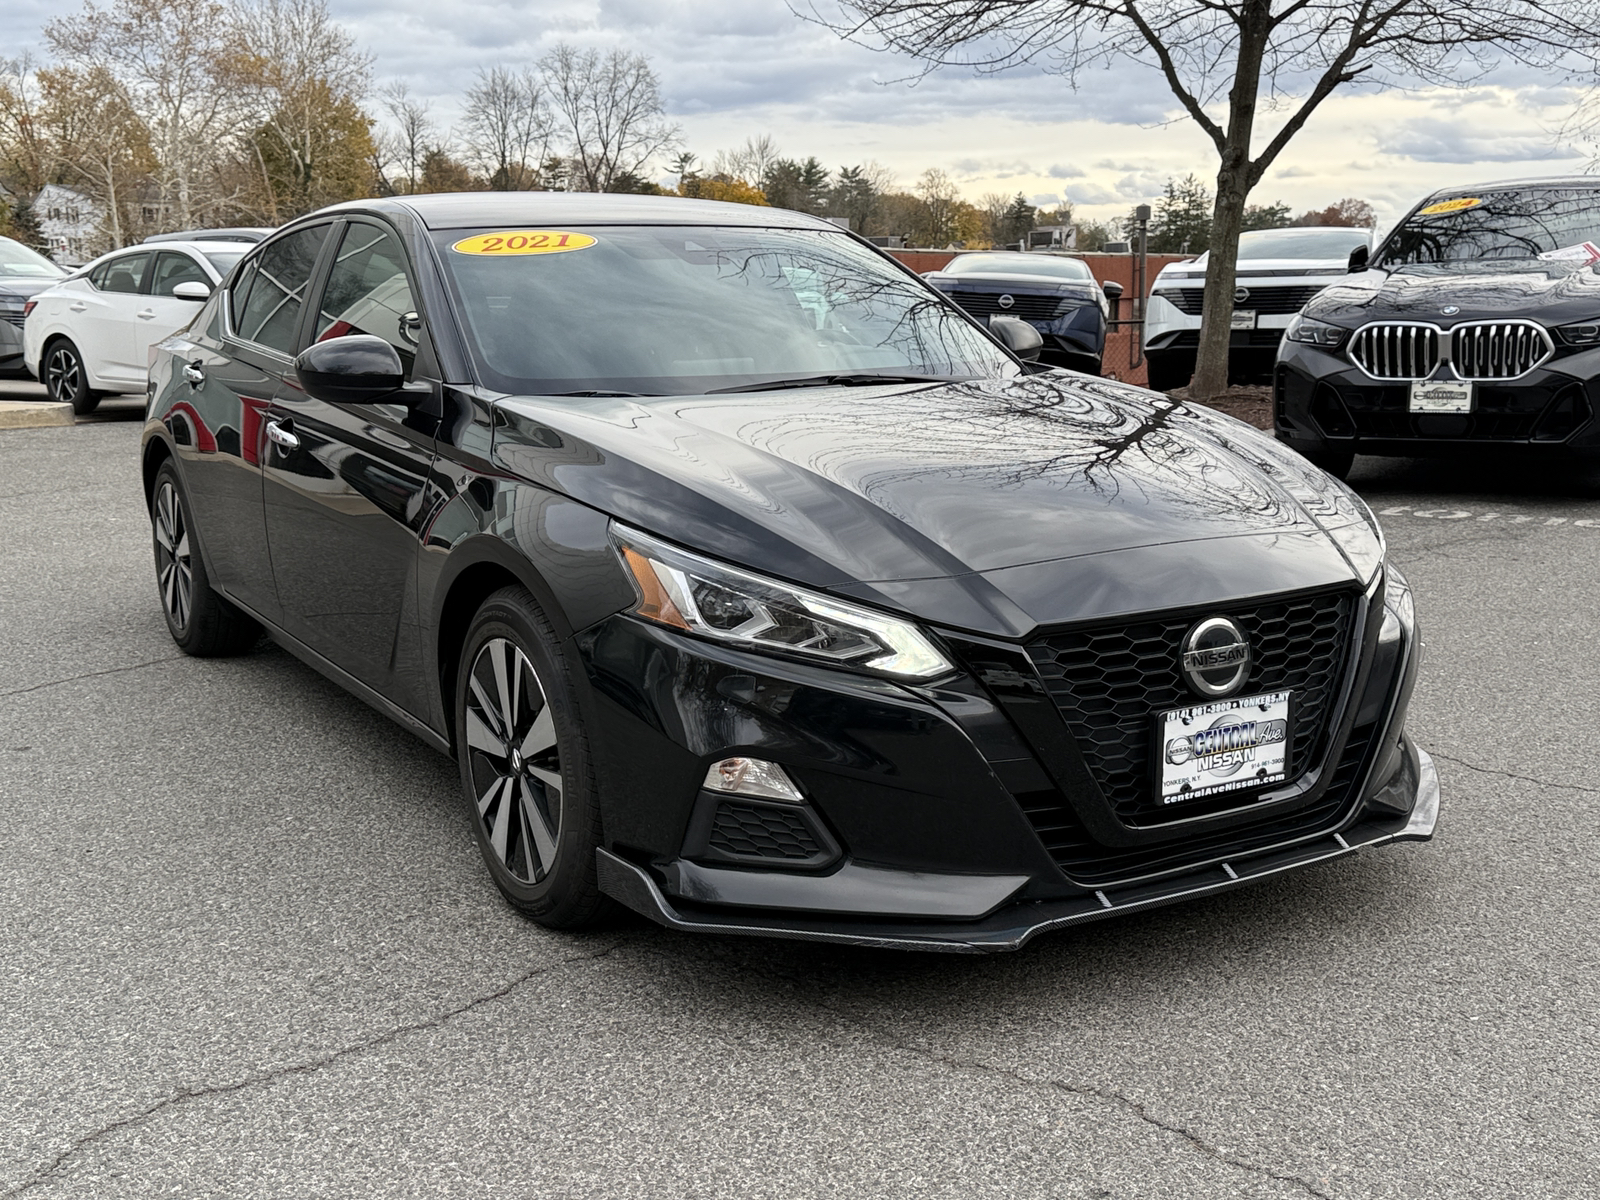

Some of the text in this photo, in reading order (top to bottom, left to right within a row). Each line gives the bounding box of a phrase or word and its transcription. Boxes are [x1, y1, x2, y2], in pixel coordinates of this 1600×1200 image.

[1429, 199, 1474, 213] 2024
[481, 234, 571, 253] 2021
[1191, 648, 1246, 668] NISSAN
[1193, 721, 1284, 758] CENTRAL Ave.
[1168, 745, 1193, 755] NISSAN
[1197, 748, 1256, 773] NISSAN
[1250, 757, 1286, 769] 914-961-3900
[1163, 773, 1286, 804] CentralAveNissan.com
